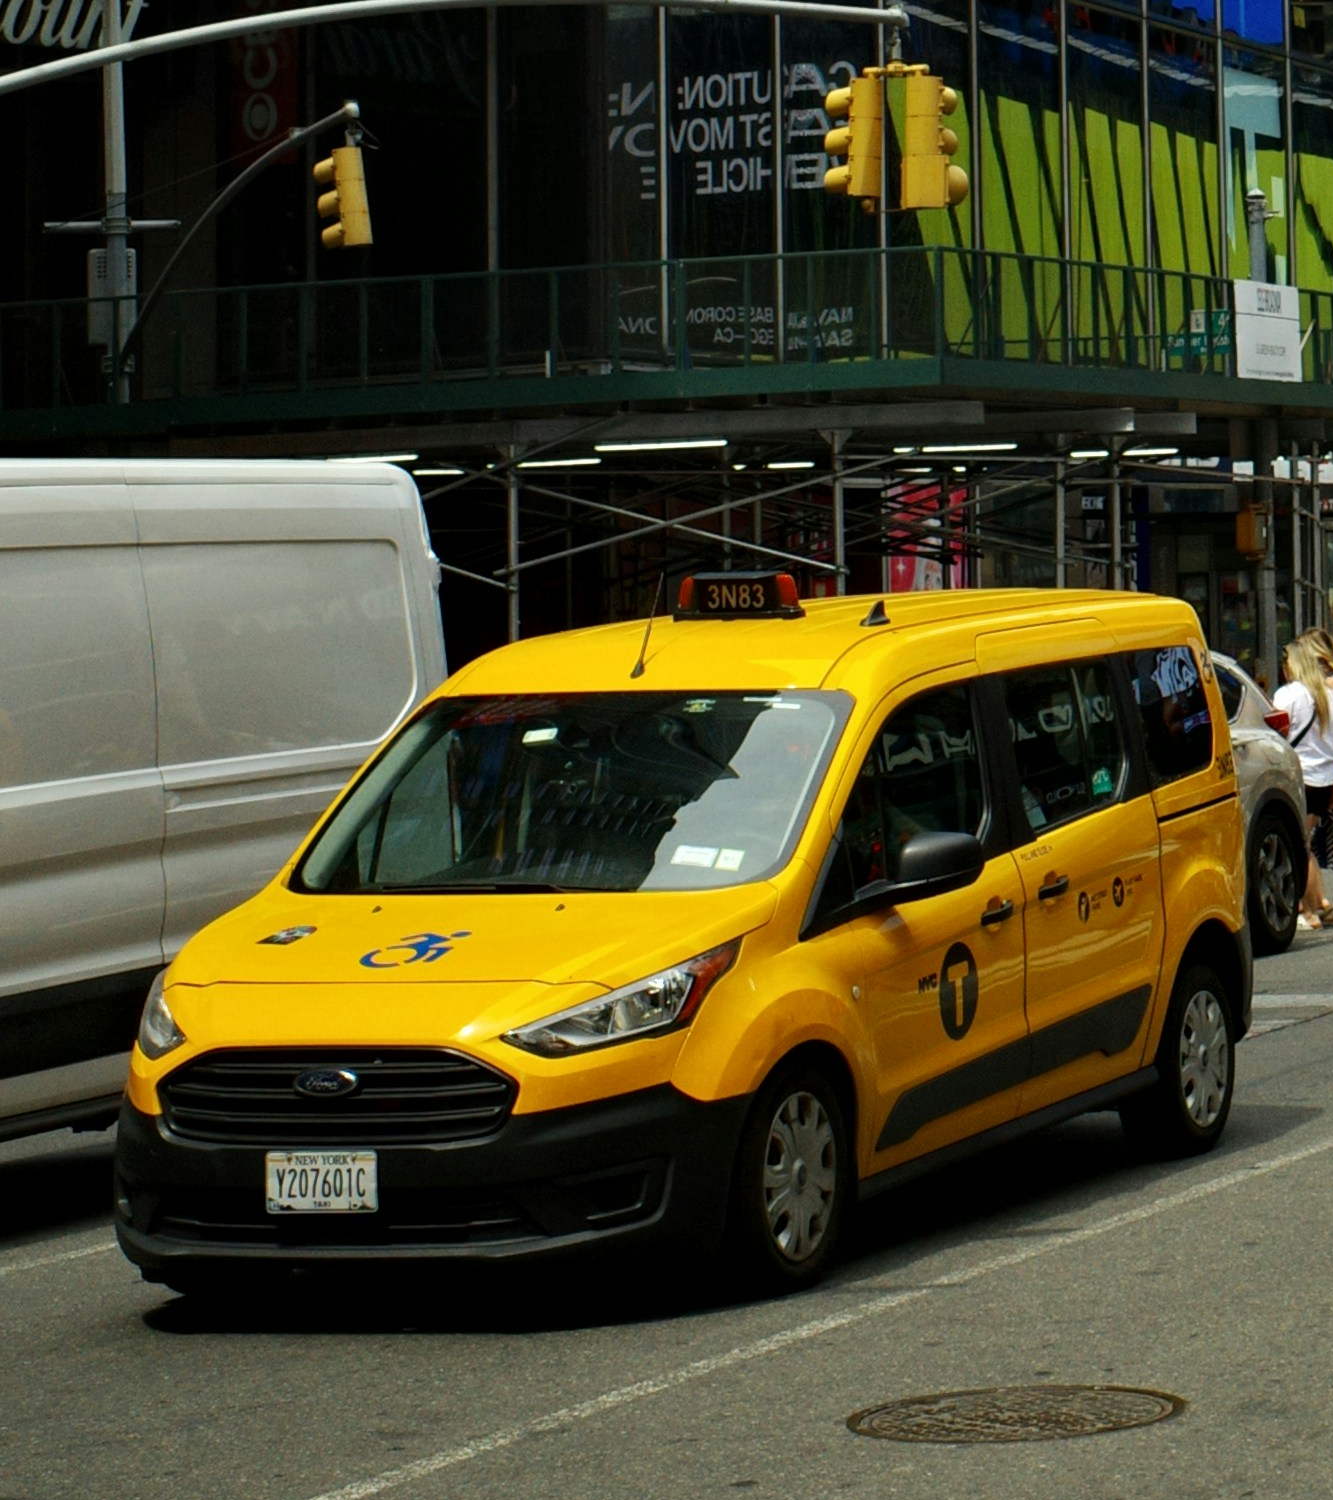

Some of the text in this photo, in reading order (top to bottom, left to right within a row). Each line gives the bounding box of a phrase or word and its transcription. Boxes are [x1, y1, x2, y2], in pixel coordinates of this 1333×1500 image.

[707, 584, 765, 610] 3N83
[918, 959, 970, 1028] NYC T
[294, 1154, 348, 1166] NEW YORK
[275, 1167, 367, 1199] Y207601C
